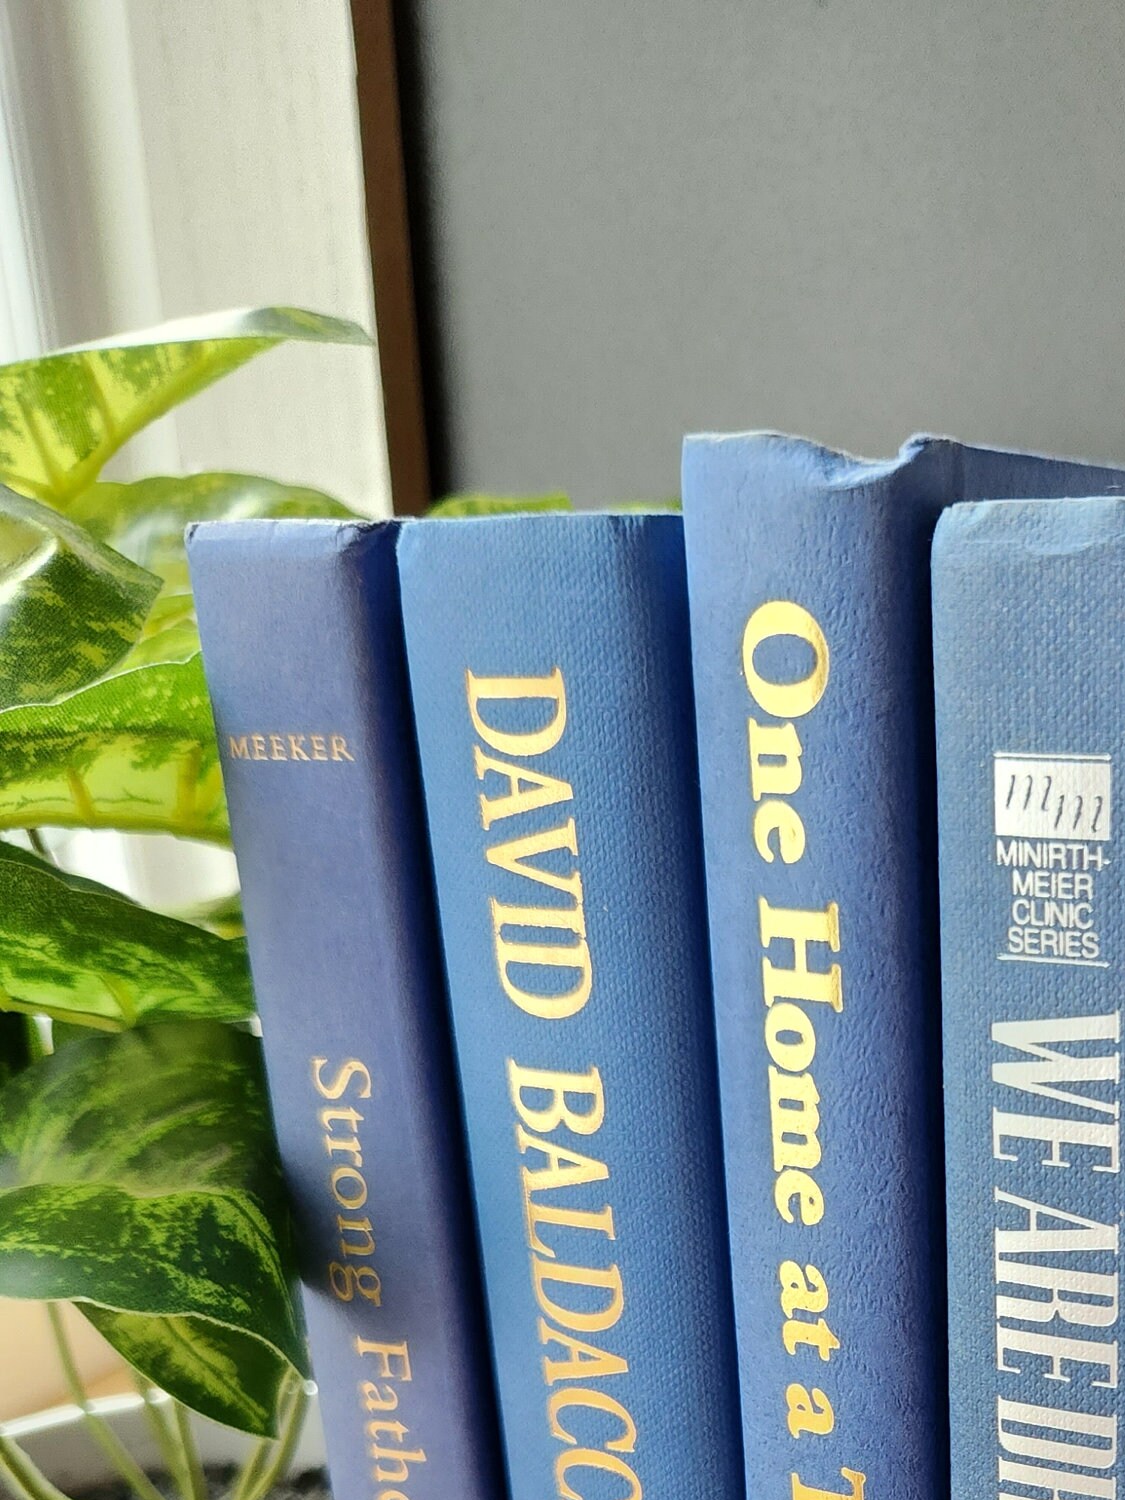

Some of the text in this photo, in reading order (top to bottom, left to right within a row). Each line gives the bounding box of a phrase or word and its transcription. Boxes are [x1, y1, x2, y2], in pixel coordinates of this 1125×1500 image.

[229, 733, 355, 761] MEEKER
[743, 600, 829, 863] One
[466, 666, 593, 1020] DAVID
[996, 840, 1111, 871] MINIRTH-
[1012, 870, 1094, 900] MEIER
[1008, 927, 1099, 958] SERIES
[1012, 900, 1094, 929] CLINIC
[759, 897, 844, 1226] Home
[991, 1010, 1120, 1173] WE
[312, 1057, 381, 1308] Strong
[779, 1260, 840, 1361] at
[995, 1186, 1119, 1388] ARE
[785, 1384, 834, 1438] a
